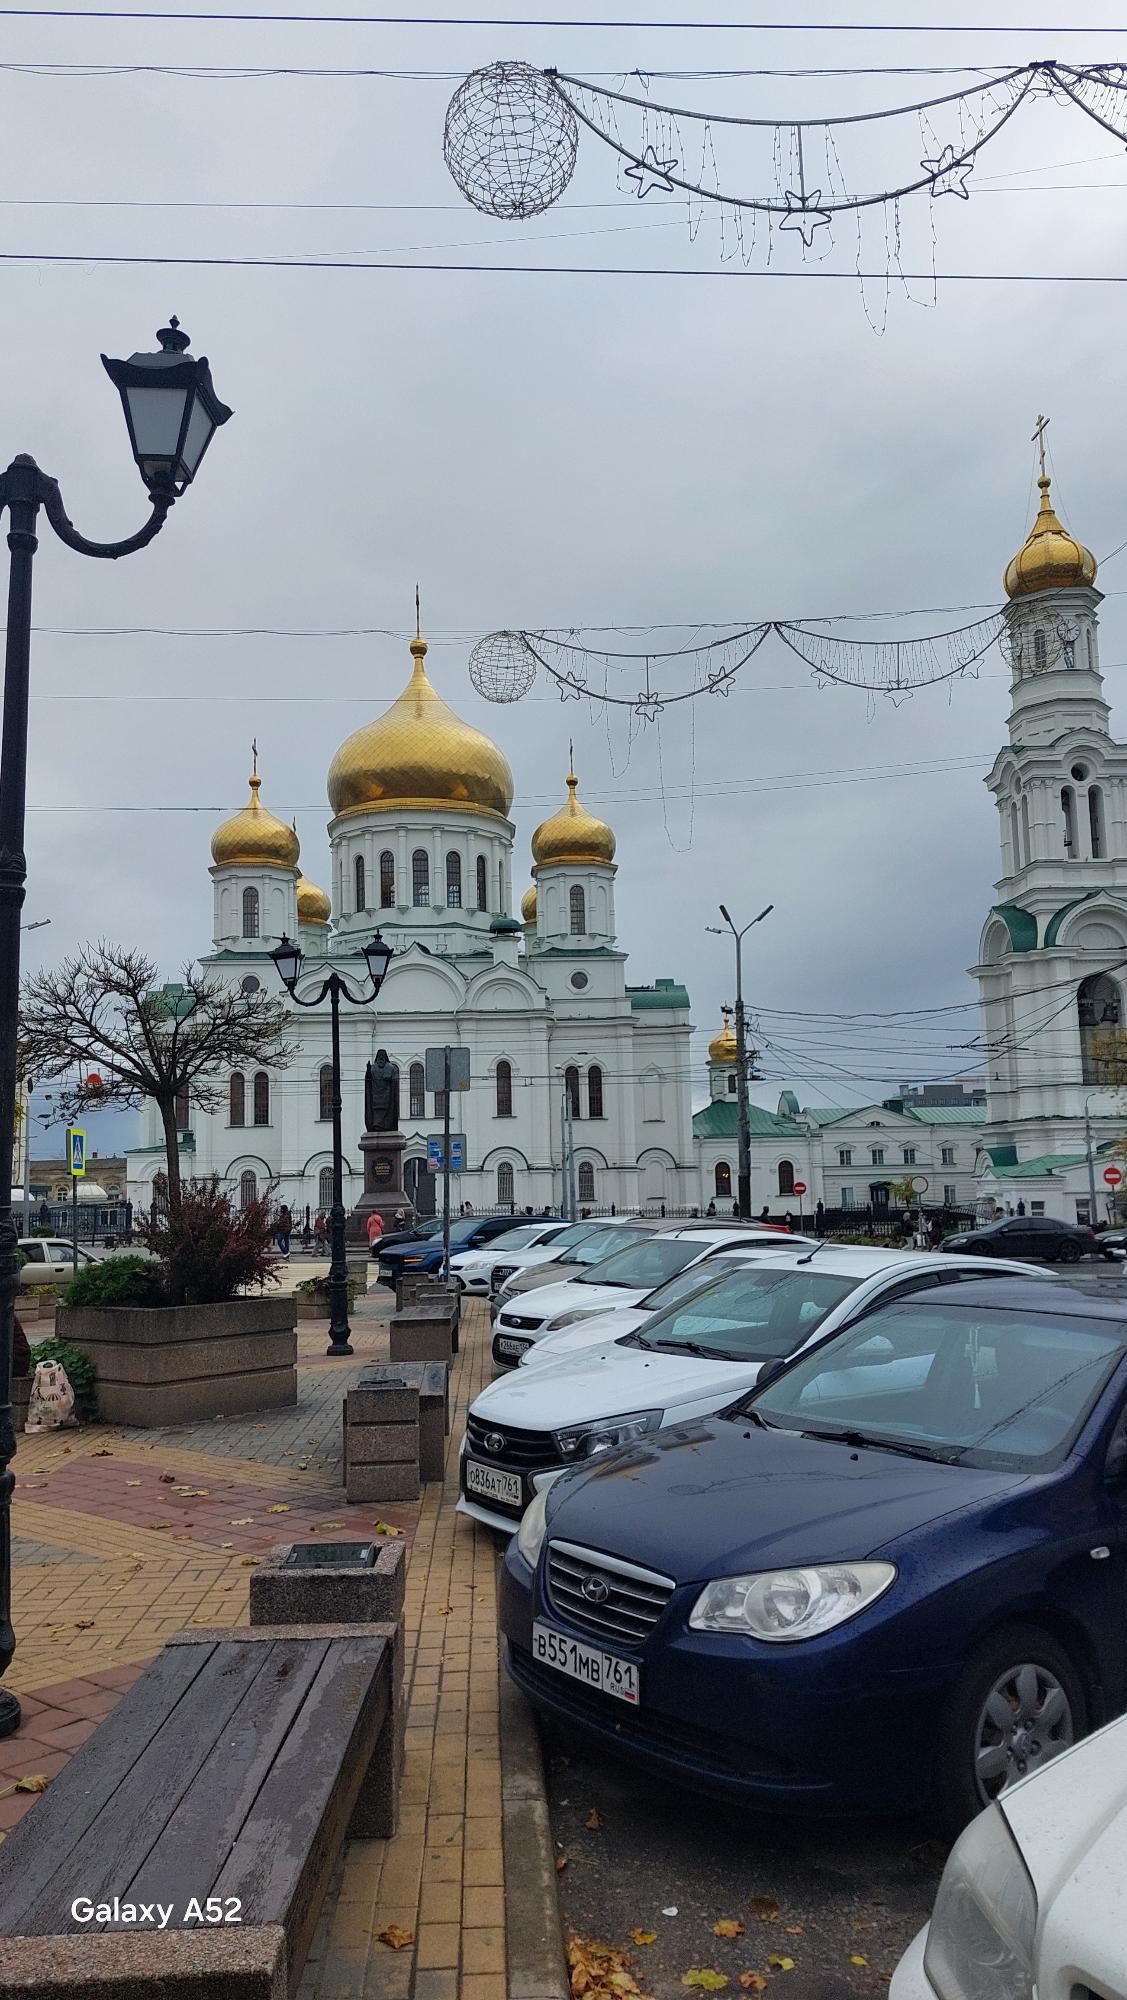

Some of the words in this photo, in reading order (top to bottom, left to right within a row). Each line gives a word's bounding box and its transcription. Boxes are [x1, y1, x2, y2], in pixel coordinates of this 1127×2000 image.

[503, 1475, 518, 1494] 761
[538, 1633, 600, 1682] В551МВ
[604, 1655, 633, 1688] 761
